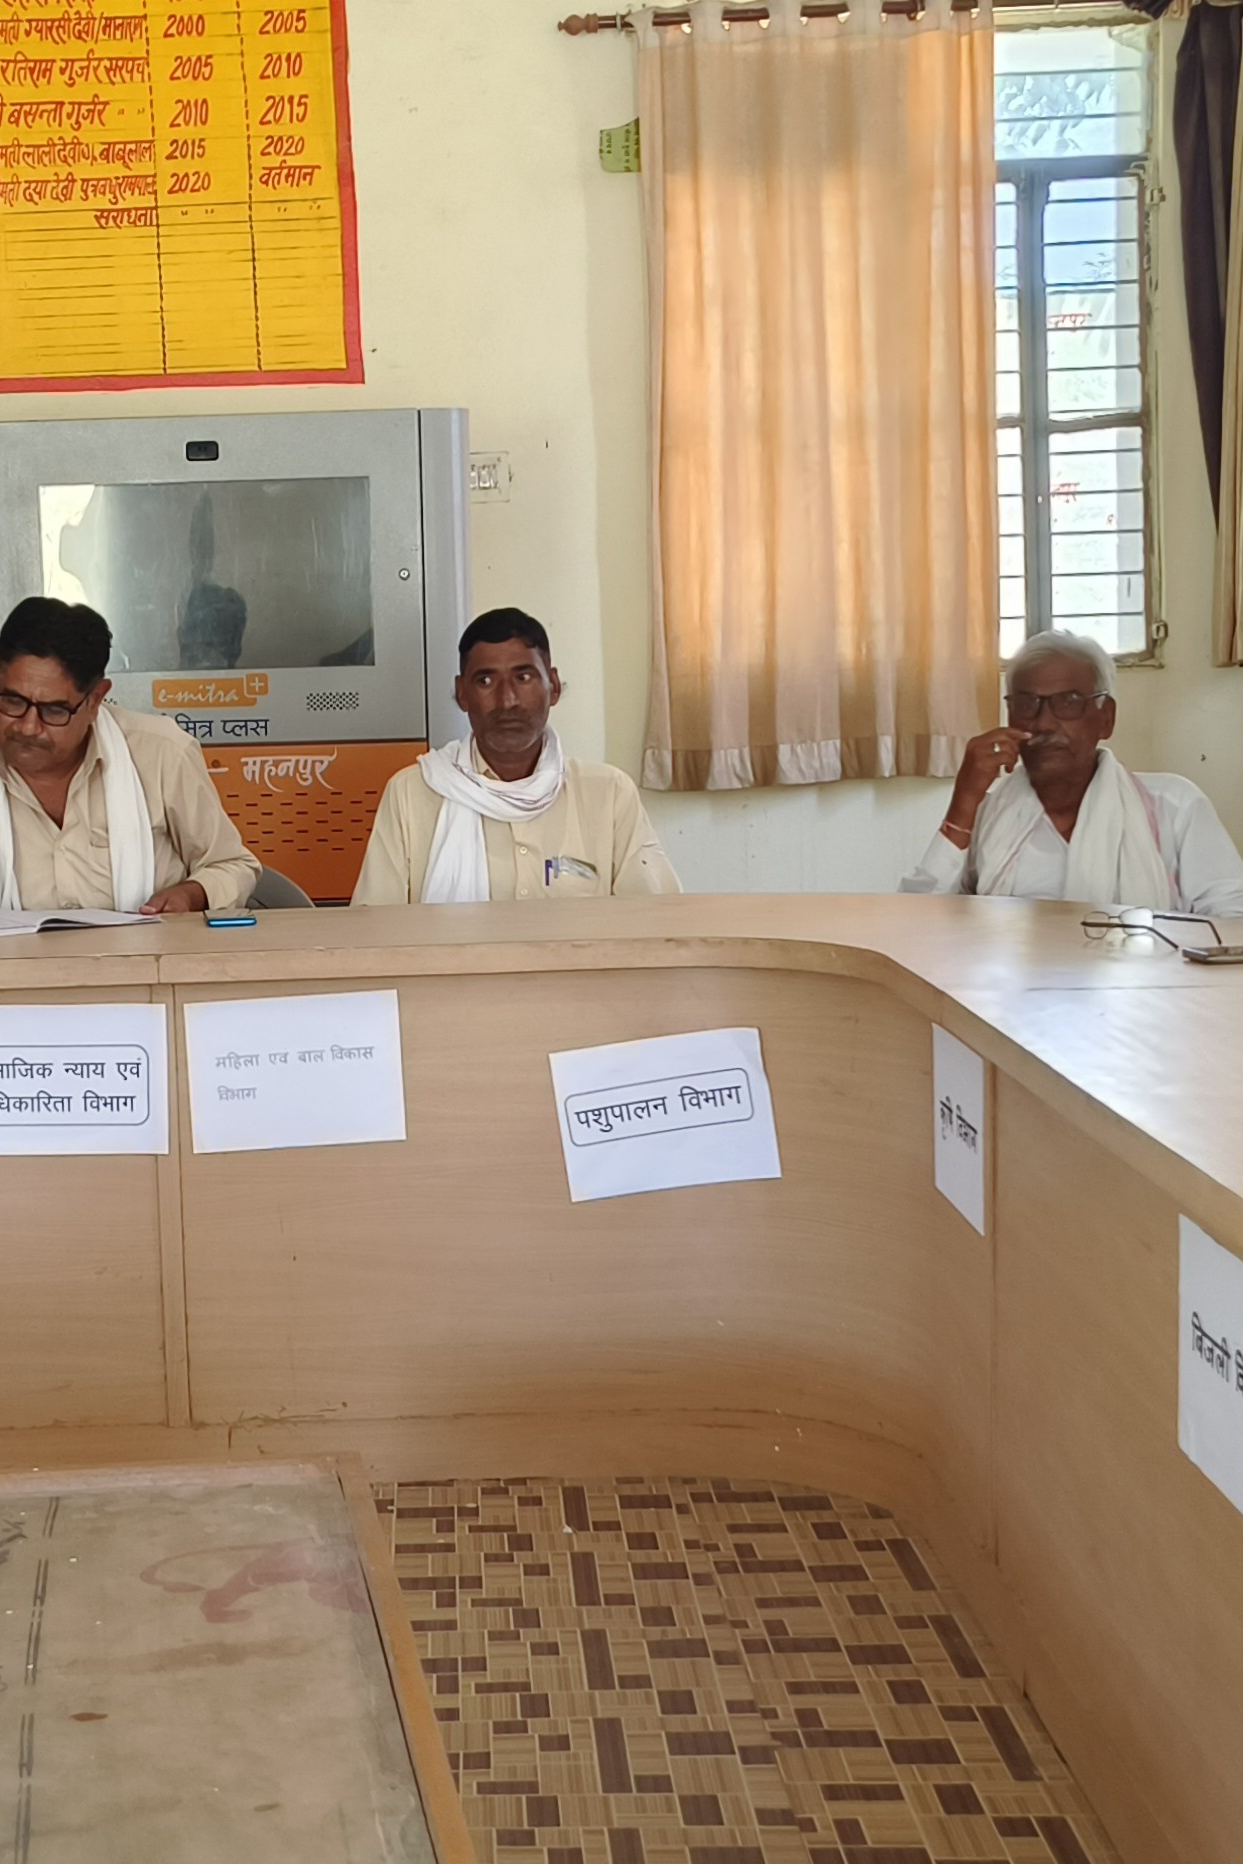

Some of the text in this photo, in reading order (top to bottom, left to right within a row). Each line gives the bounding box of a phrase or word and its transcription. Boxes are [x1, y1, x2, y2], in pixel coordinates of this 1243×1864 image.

[163, 14, 205, 38] 2000
[259, 9, 307, 35] 2005
[0, 50, 56, 88] रतिराम
[169, 54, 214, 81] 2005
[259, 52, 303, 80] 2010
[169, 98, 208, 128] 2010
[259, 94, 309, 125] 2015
[165, 138, 206, 160] 2015
[259, 135, 305, 156] 2020
[167, 171, 211, 194] 2020
[259, 159, 321, 190] वर्तमान
[220, 718, 269, 737] प्लस
[241, 746, 337, 792] महनपुर
[63, 1062, 106, 1080] न्याय
[116, 1056, 143, 1080] एवं
[215, 1052, 259, 1069] महिला
[330, 1044, 375, 1060] विकास
[82, 1090, 136, 1113] विभाग
[217, 1085, 257, 1101] विभाग
[574, 1085, 742, 1133] पशुपालन विभाग
